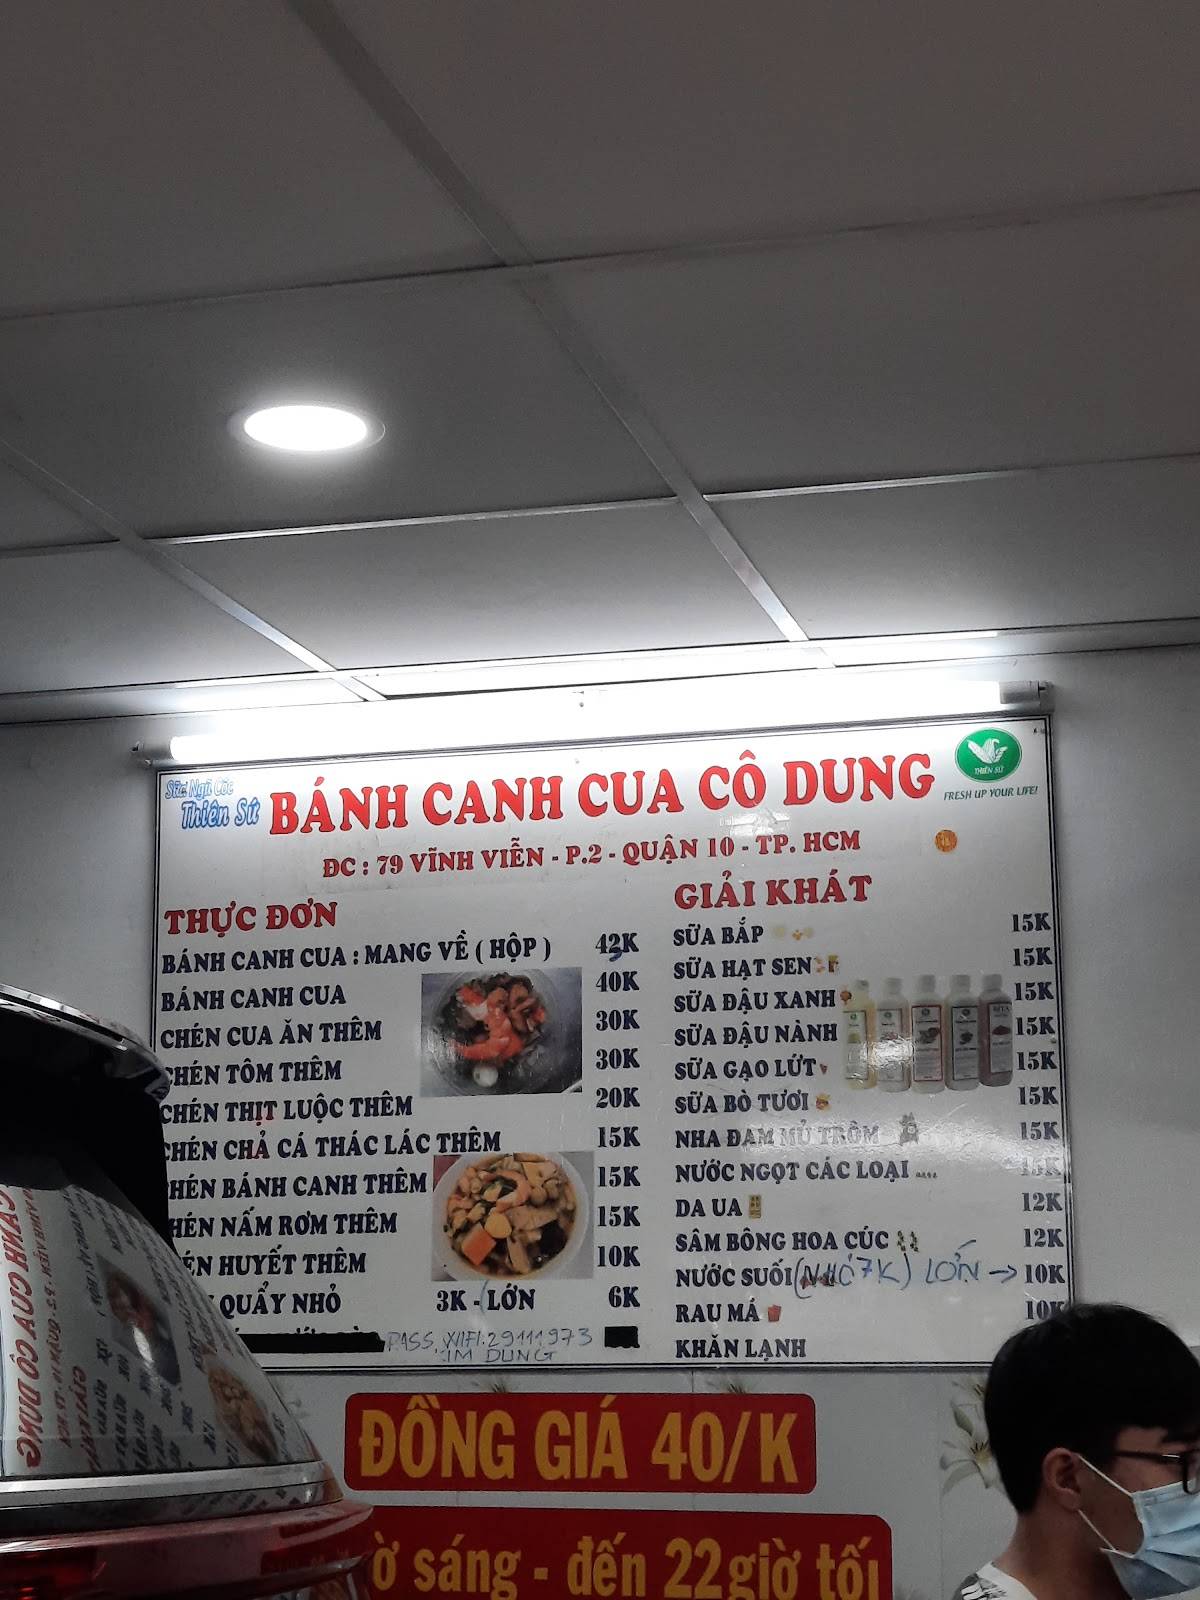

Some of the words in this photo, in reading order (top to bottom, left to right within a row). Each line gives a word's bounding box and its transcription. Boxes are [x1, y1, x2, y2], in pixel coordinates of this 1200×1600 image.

[270, 777, 408, 835] BÁNH
[423, 776, 563, 826] CANH
[577, 768, 682, 817] CUA
[699, 750, 766, 810] CÔ
[783, 754, 935, 805] DUNG
[944, 791, 972, 801] FRESH
[975, 790, 987, 798] UP
[990, 788, 1014, 797] YOUR
[1017, 786, 1039, 795] LIFE!
[182, 799, 230, 829] Thiên
[235, 797, 260, 826] Sứ
[323, 857, 356, 877] ĐC
[377, 855, 403, 875] 79
[410, 847, 474, 872] VĨNH
[481, 837, 544, 869] VIỄN
[566, 844, 602, 864] P.2
[621, 834, 698, 864] QUẬN
[708, 837, 734, 857] 10
[755, 834, 795, 854] TP.
[803, 830, 860, 852] HCM
[675, 870, 755, 909] GIẢI
[766, 869, 872, 905] KHÁT
[164, 901, 256, 938] THỰC
[265, 898, 337, 929] ĐƠN
[1012, 912, 1051, 932] 15K
[673, 923, 716, 946] SỮA
[721, 917, 763, 944] BẮP
[162, 948, 225, 974] BÁNH
[231, 949, 294, 971] CANH
[300, 947, 347, 967] CUA
[364, 942, 432, 964] MANG
[438, 930, 469, 961] VỀ
[490, 932, 536, 963] HỘP
[595, 933, 638, 956] 42K
[1013, 947, 1053, 966] 15K
[674, 956, 716, 979] SỮA
[722, 959, 766, 981] HẠT
[772, 957, 812, 976] SEN
[596, 971, 639, 992] 40K
[1015, 982, 1054, 1000] 15K
[161, 986, 224, 1012] BÁNH
[231, 987, 294, 1008] CANH
[300, 984, 346, 1006] CUA
[674, 990, 716, 1012] SỮA
[722, 987, 768, 1015] ĐẬU
[774, 990, 835, 1009] XANH
[160, 1023, 221, 1049] CHÉN
[227, 1025, 273, 1046] CUA
[279, 1019, 313, 1044] ĂN
[319, 1016, 382, 1042] THÊM
[596, 1009, 640, 1031] 30K
[1016, 1016, 1055, 1036] 15K
[675, 1023, 717, 1046] SỮA
[723, 1021, 769, 1048] ĐẬU
[775, 1020, 837, 1043] NÀNH
[226, 1058, 273, 1084] TÔM
[279, 1055, 342, 1082] THÊM
[596, 1048, 640, 1070] 30K
[675, 1057, 717, 1080] SỮA
[723, 1060, 769, 1082] GẠO
[774, 1053, 816, 1077] LỨT
[1017, 1051, 1057, 1070] 15K
[161, 1098, 219, 1124] CHÉN
[225, 1101, 277, 1126] THỊT
[283, 1092, 343, 1124] LUỘC
[349, 1090, 413, 1117] THÊM
[596, 1087, 640, 1108] 20K
[675, 1091, 718, 1114] SỮA
[723, 1089, 751, 1112] BÒ
[758, 1089, 808, 1112] TƯƠI
[1018, 1086, 1058, 1105] 15K
[224, 1130, 270, 1160] CHẢ
[277, 1132, 308, 1159] CÁ
[315, 1130, 378, 1157] THÁC
[384, 1133, 430, 1155] LÁC
[436, 1126, 501, 1153] THÊM
[598, 1126, 640, 1148] 15K
[675, 1129, 721, 1148] NHA
[1021, 1122, 1059, 1140] 15K
[168, 1173, 217, 1201] HÉN
[222, 1172, 287, 1198] BÁNH
[293, 1174, 357, 1196] CANH
[363, 1167, 427, 1194] THÊM
[598, 1166, 640, 1187] 15K
[675, 1159, 734, 1183] NƯỚC
[740, 1162, 799, 1184] NGỌT
[806, 1161, 850, 1180] CÁC
[856, 1160, 909, 1182] LOẠI
[676, 1199, 706, 1217] DA
[712, 1198, 742, 1216] UA
[1022, 1193, 1063, 1212] 12K
[171, 1213, 215, 1239] HÉN
[220, 1206, 272, 1237] NẤM
[278, 1210, 328, 1236] RƠM
[333, 1207, 397, 1234] THÊM
[598, 1206, 640, 1227] 15K
[676, 1228, 721, 1252] SÂM
[726, 1227, 786, 1251] BÔNG
[792, 1231, 838, 1250] HOA
[844, 1226, 888, 1249] CÚC
[1024, 1228, 1064, 1247] 12K
[218, 1244, 297, 1276] HUYẾT
[302, 1246, 366, 1274] THÊM
[598, 1245, 640, 1267] 10K
[676, 1263, 735, 1287] NƯỚC
[741, 1258, 792, 1287] SUỐI
[1025, 1264, 1065, 1284] 10K
[219, 1281, 286, 1319] QUẨY
[292, 1283, 341, 1314] NHỎ
[437, 1290, 467, 1312] 3K
[487, 1283, 535, 1311] LỚN
[609, 1286, 640, 1308] 6K
[676, 1304, 722, 1323] RAU
[728, 1298, 760, 1322] MÁ
[676, 1334, 739, 1358] KHĂN
[745, 1339, 806, 1361] LẠNH
[358, 1394, 515, 1482] ĐỒNG
[535, 1394, 628, 1482] GIÁ
[651, 1410, 800, 1486] 40/K
[413, 1533, 521, 1600] sáng
[567, 1532, 646, 1600] đến
[817, 1536, 879, 1600] tối
